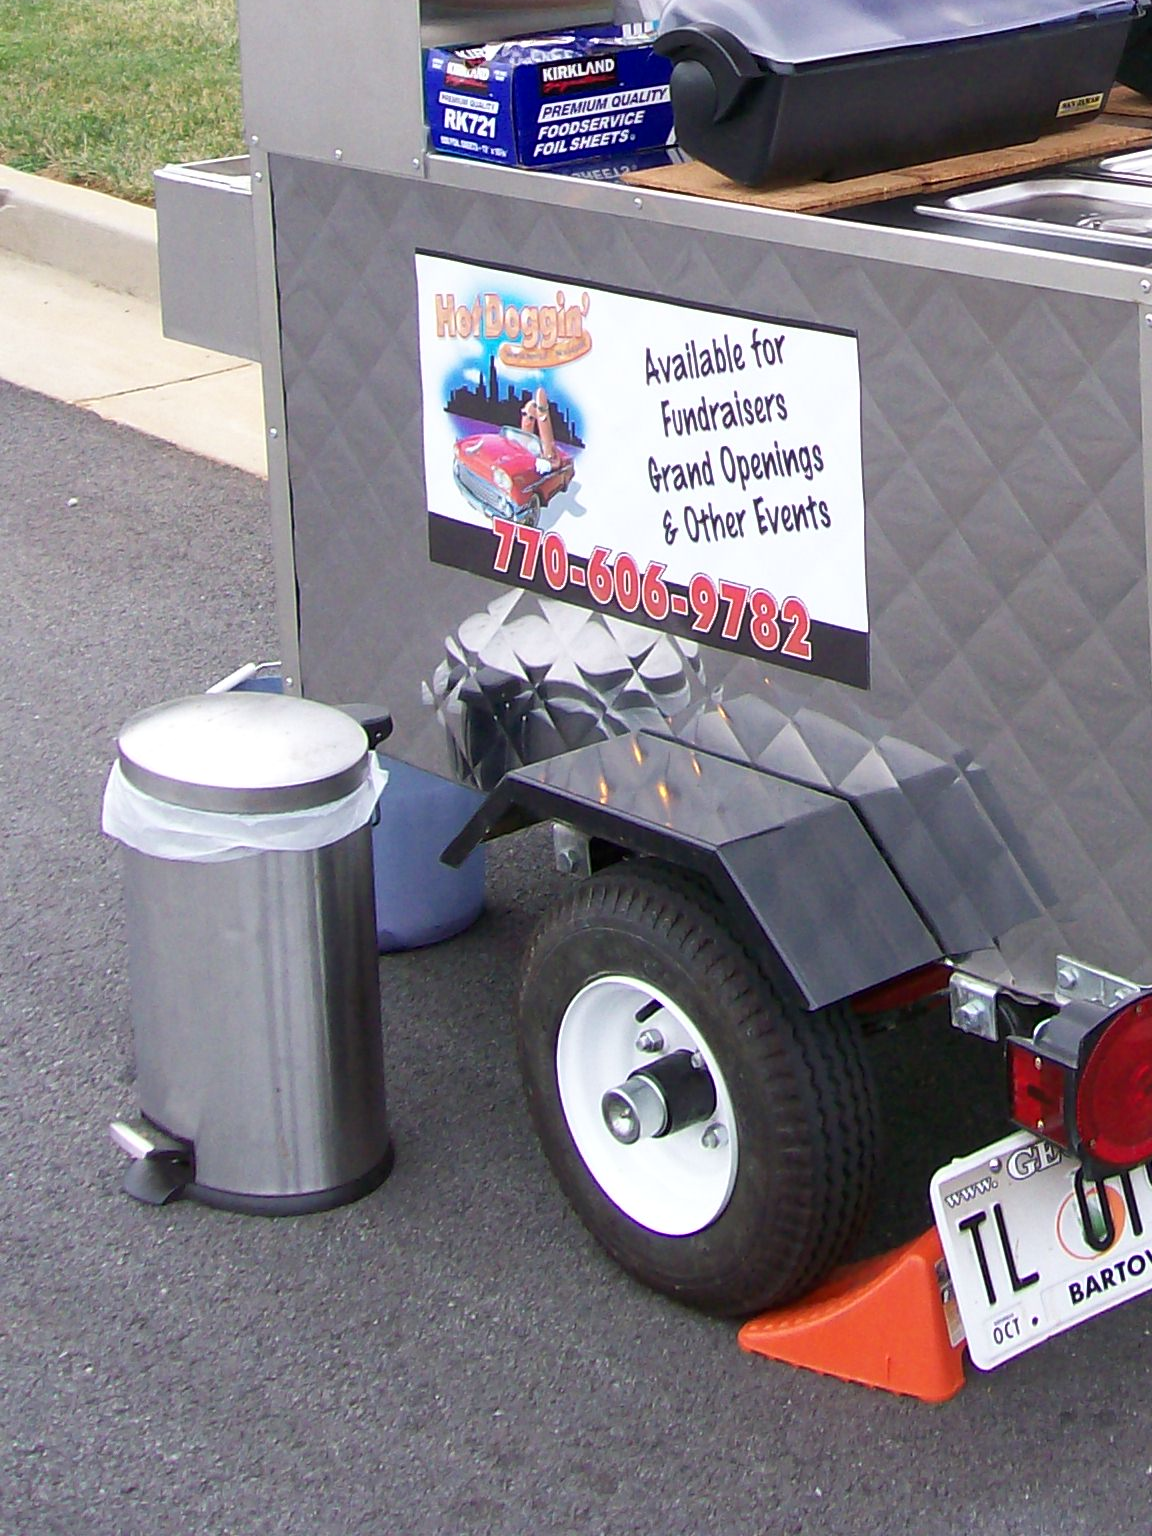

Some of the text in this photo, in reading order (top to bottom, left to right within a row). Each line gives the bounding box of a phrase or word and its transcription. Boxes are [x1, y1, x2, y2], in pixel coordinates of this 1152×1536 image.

[542, 58, 615, 82] KIRKLAND
[444, 108, 497, 139] RK721
[541, 86, 669, 120] PREMIUM QUALITY
[533, 129, 630, 158] FOIL SHEETS
[537, 110, 645, 141] FOODSERVICE
[645, 327, 787, 386] Available for
[661, 390, 789, 438] Fundraisers
[648, 439, 824, 494] Grand Openings
[662, 494, 832, 546] & Other Events
[492, 517, 813, 661] 770-606-9782
[958, 1202, 1040, 1306] TL
[993, 1317, 1021, 1345] OCT
